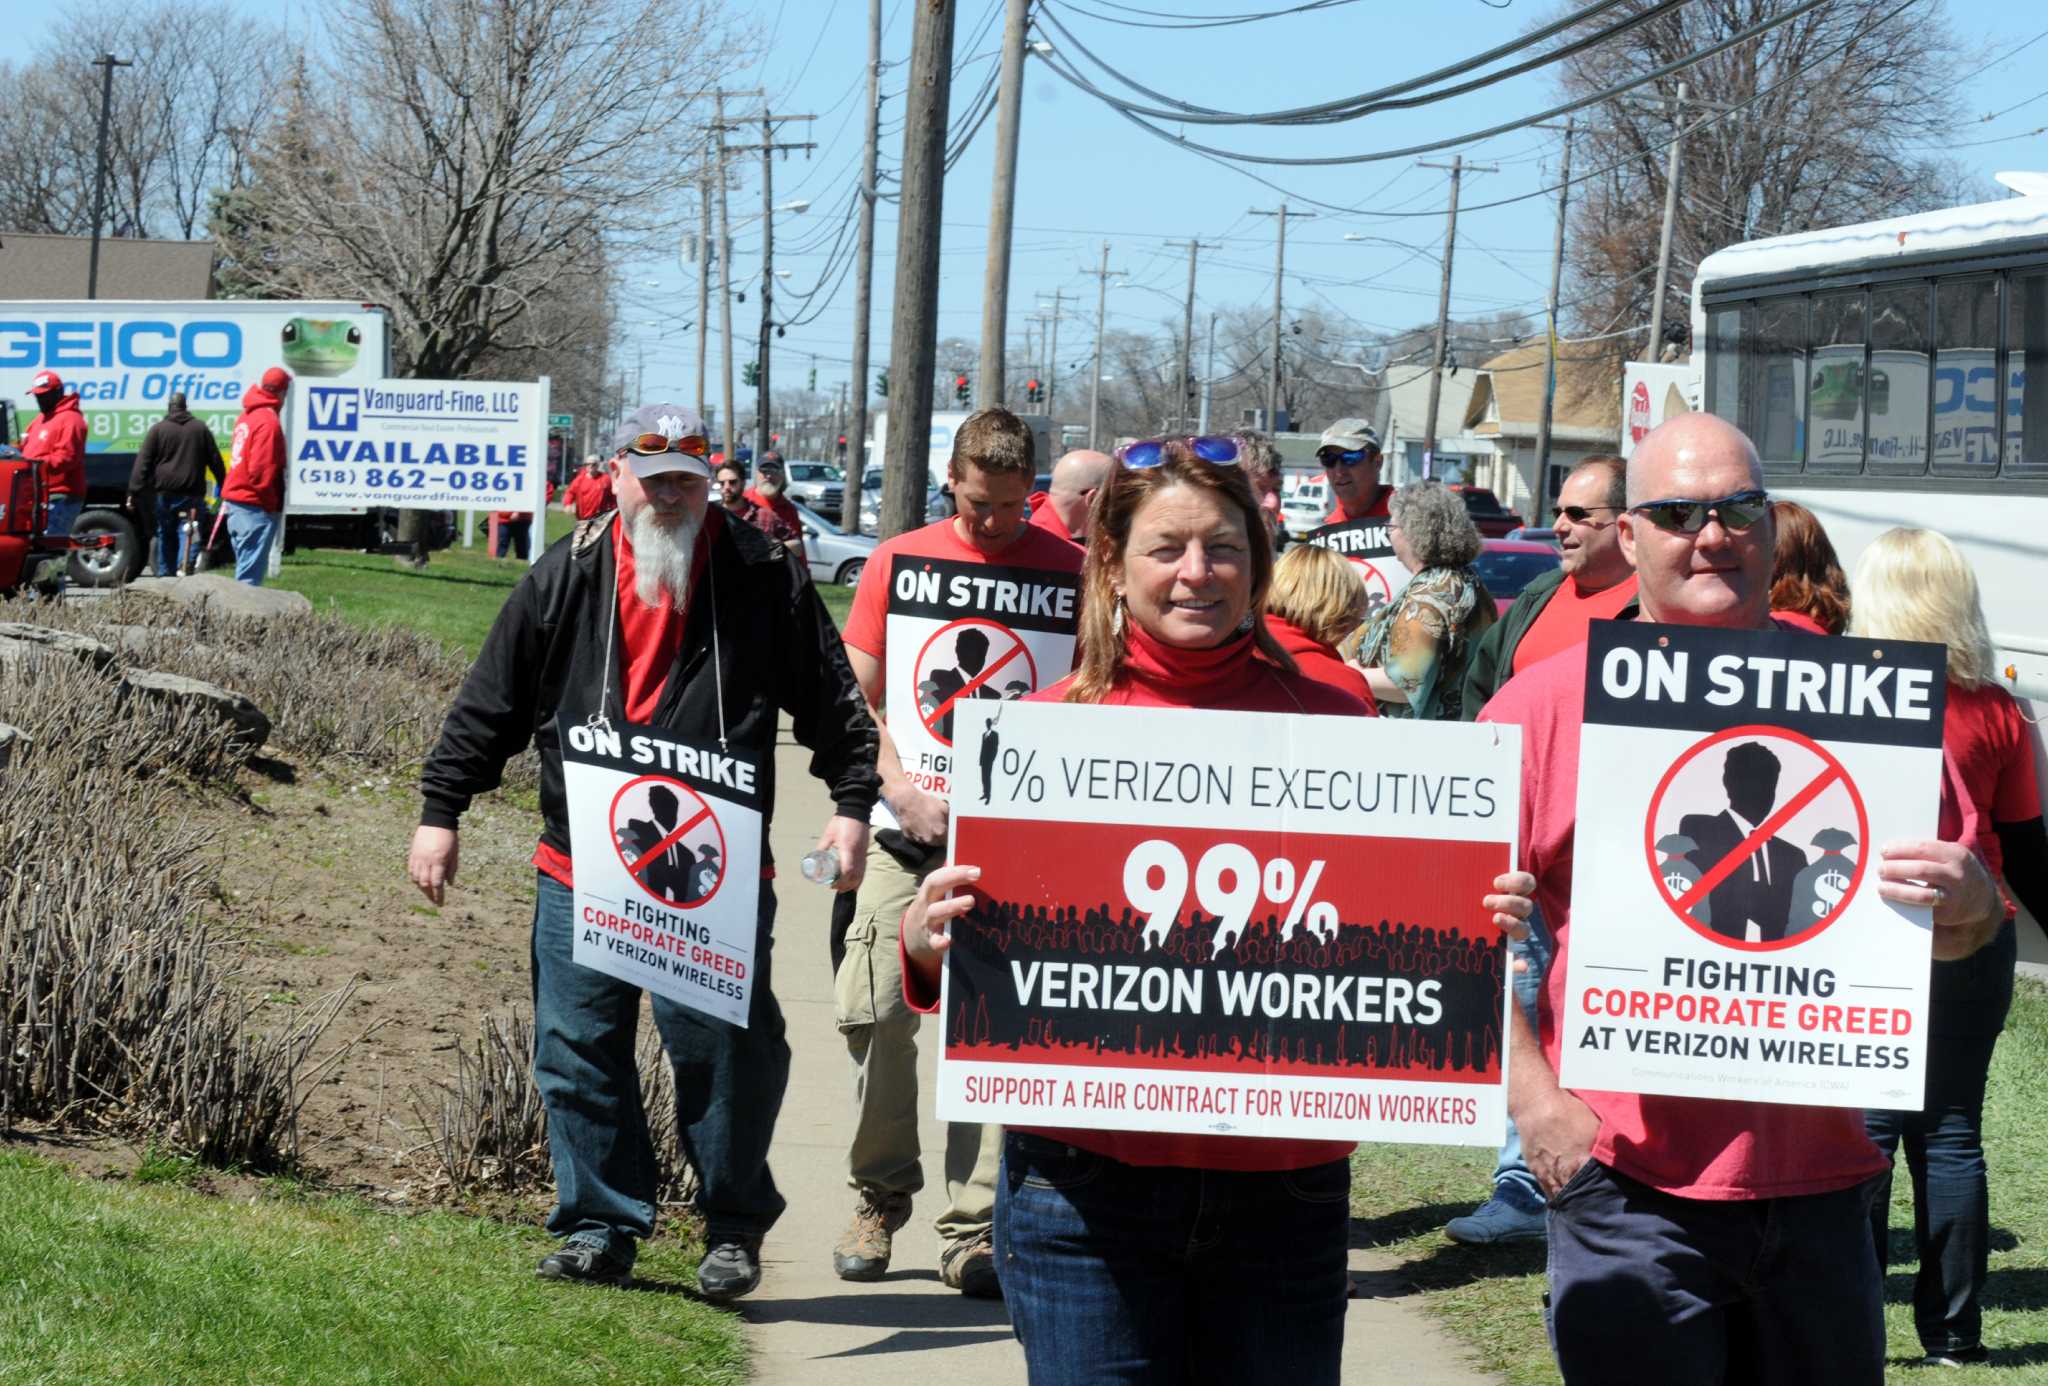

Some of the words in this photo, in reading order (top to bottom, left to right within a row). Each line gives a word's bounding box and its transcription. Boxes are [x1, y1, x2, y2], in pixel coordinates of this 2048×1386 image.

[0, 321, 242, 368] GEICO
[64, 374, 129, 400] ocal
[142, 373, 241, 400] Office
[310, 391, 358, 426] VF
[364, 387, 489, 413] Vanguard-Fine,
[492, 392, 519, 413] LLC
[298, 440, 527, 466] AVAILABLE
[299, 468, 356, 485] (518)
[366, 469, 524, 491] 862-0861
[315, 490, 507, 503] www.vanguardfine.com
[1328, 526, 1392, 553] STRIK
[896, 569, 941, 604] ON
[947, 575, 1076, 619] STRIKE
[1602, 646, 1689, 703] ON
[1704, 653, 1933, 721] STRIKE
[568, 725, 622, 758] ON
[630, 735, 756, 795] STRIKE
[1061, 756, 1232, 806] VERIZON
[1250, 767, 1496, 818] EXECUTIVES
[625, 898, 711, 945] FIGHTING
[1123, 839, 1340, 961] 99%
[583, 906, 687, 958] CORPORATE
[691, 944, 747, 980] GREED
[583, 929, 602, 945] AT
[606, 936, 668, 972] VERIZON
[672, 959, 744, 1001] WIRELESS
[1010, 960, 1203, 1016] VERIZON
[1216, 970, 1443, 1026] WORKERS
[1662, 956, 1836, 997] FIGHTING
[1582, 987, 1786, 1029] CORPORATE
[1798, 1004, 1913, 1036] GREED
[1579, 1026, 1617, 1050] AT
[1625, 1028, 1749, 1061] VERIZON
[1759, 1038, 1910, 1070] WIRELESS
[965, 1076, 1058, 1109] SUPPORT
[1062, 1080, 1077, 1108] A
[1083, 1081, 1127, 1111] FAIR
[1133, 1083, 1240, 1116] CONTRACT
[1245, 1088, 1282, 1117] FOR
[1289, 1090, 1371, 1121] VERIZON
[1378, 1094, 1478, 1126] WORKERS
